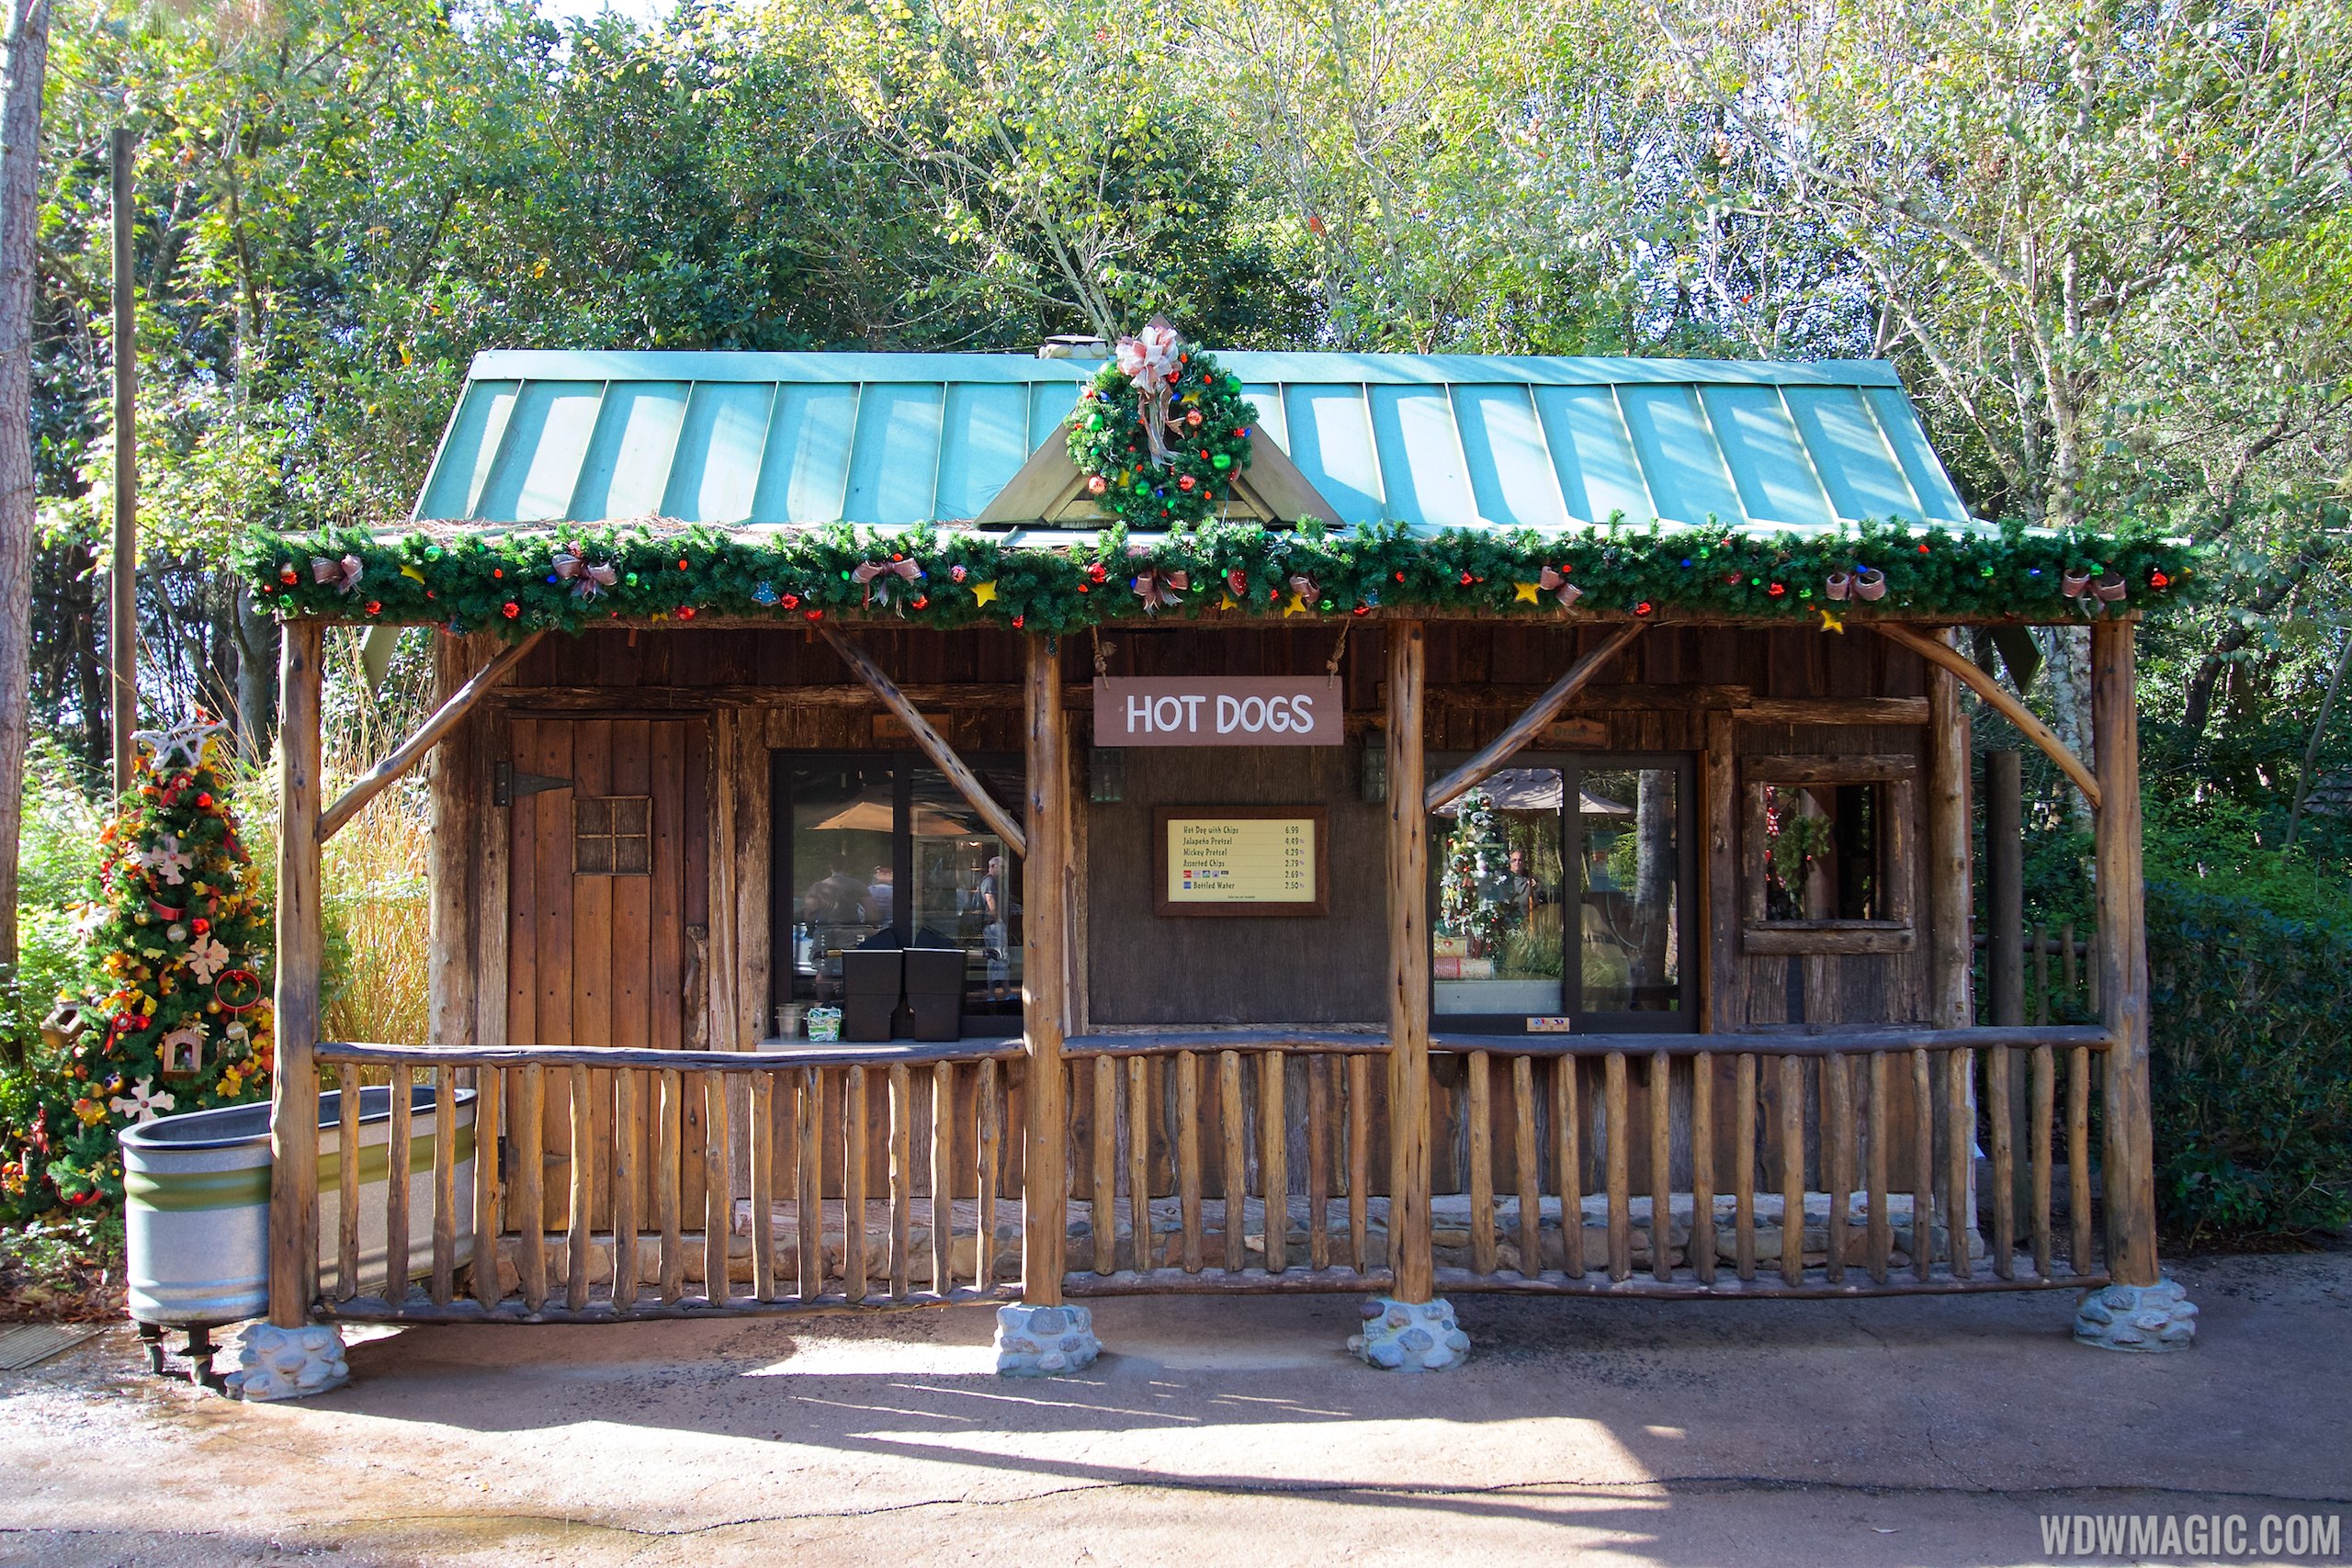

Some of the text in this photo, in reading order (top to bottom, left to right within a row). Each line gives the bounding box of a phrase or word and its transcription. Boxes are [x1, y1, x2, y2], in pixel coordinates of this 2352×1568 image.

[1126, 694, 1315, 734] HOT DOGS
[1183, 826, 1238, 835] Hot Dog with Chips
[1284, 826, 1299, 834] 6.99
[1211, 837, 1232, 845] Pretzel
[1284, 837, 1299, 845] 4.49
[1183, 848, 1227, 857] Mickey Pretzel
[1284, 848, 1299, 856] 4.29
[1183, 859, 1225, 868] Assorted Chips
[1284, 859, 1299, 867] 2.79
[1284, 870, 1299, 878] 2.69
[1193, 882, 1216, 890] Bottled
[1216, 882, 1235, 890] Water
